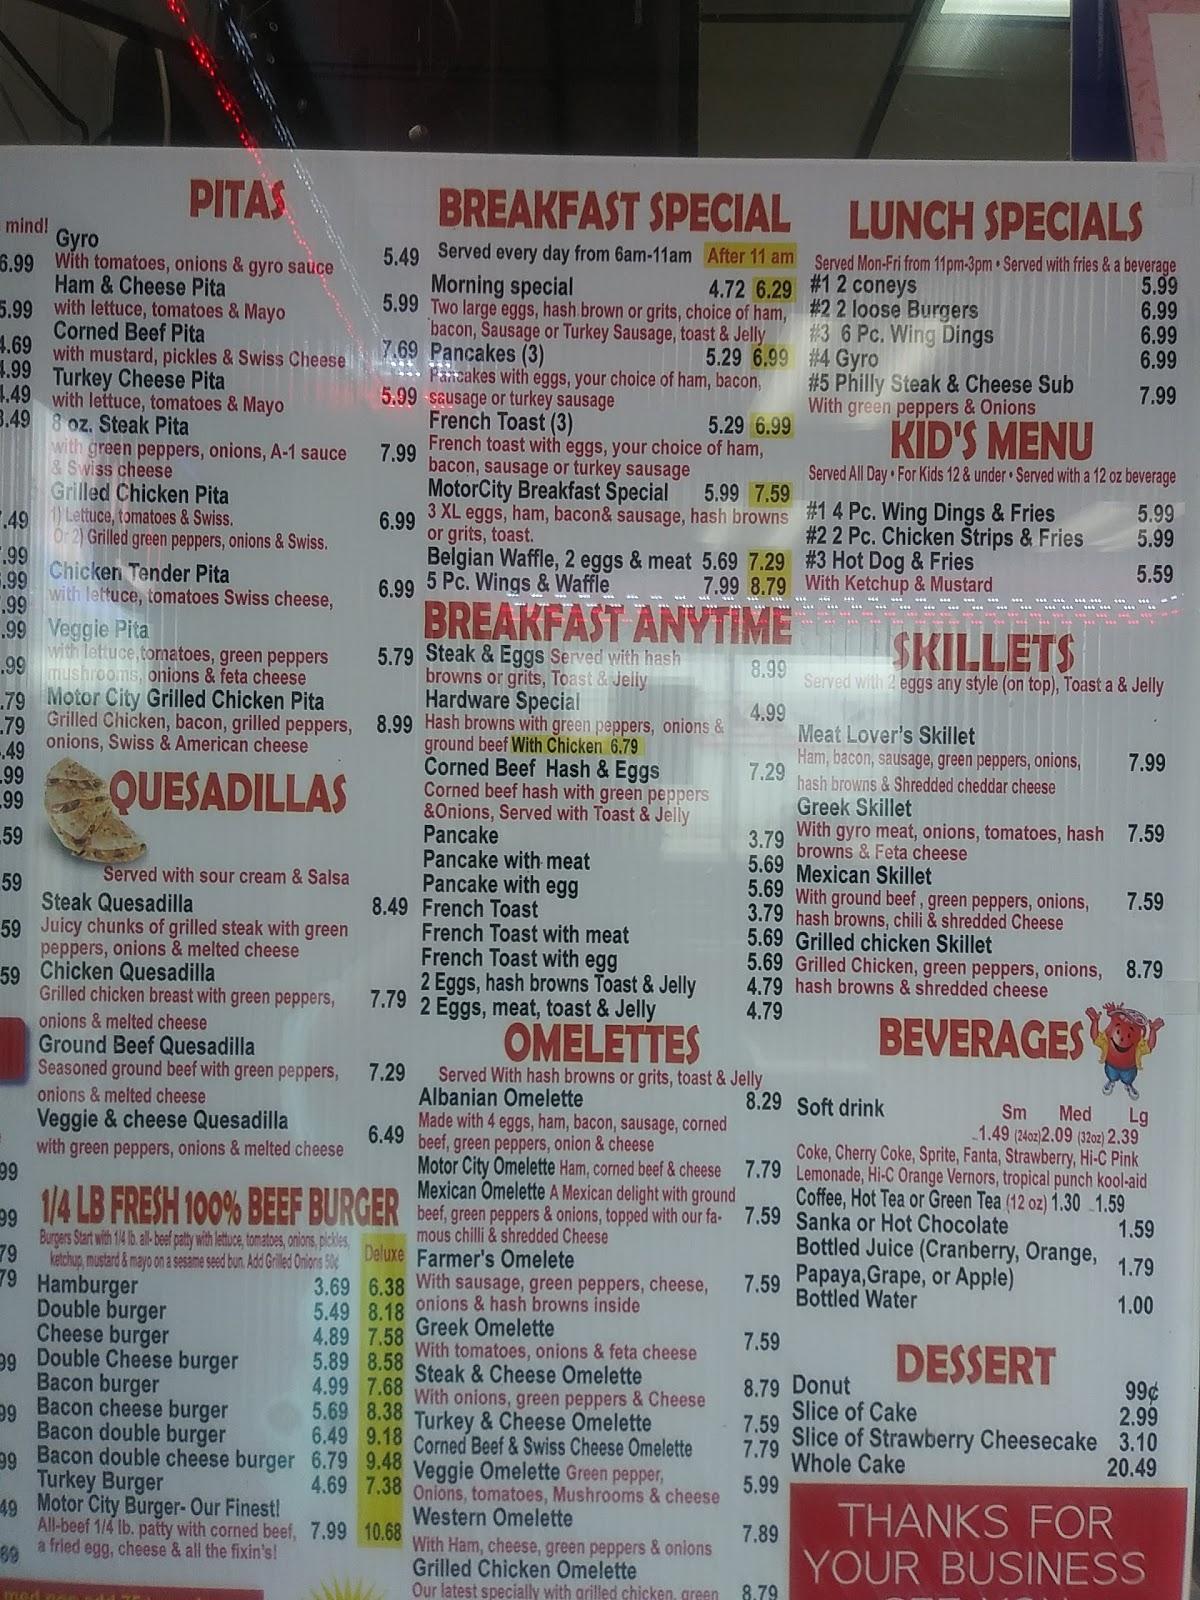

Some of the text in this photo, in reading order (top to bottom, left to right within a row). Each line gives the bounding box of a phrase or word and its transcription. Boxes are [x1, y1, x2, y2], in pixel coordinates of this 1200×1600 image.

[189, 178, 285, 221] PITAS
[439, 187, 791, 233] BREAKFAST SPECIAL
[5, 216, 48, 234] mind!
[849, 199, 1143, 242] LUNCH SPECIALS
[56, 227, 99, 251] Gyro
[383, 246, 419, 267] 5.49
[438, 241, 692, 266] Served every day from 6am-11am
[706, 246, 794, 264] After 11 am
[1003, 255, 1176, 274] Served with fries & a beverage
[55, 253, 334, 278] With tomatoes, onions & gyro sauce
[814, 254, 992, 276] Served Mon-Fri from 11pm-3pm
[55, 274, 225, 297] Ham & Cheese Pita
[431, 273, 573, 300] Morning special
[708, 279, 745, 299] 4.72
[756, 279, 792, 299] 6.29
[810, 273, 917, 299] #1 2 coneys
[1141, 275, 1178, 295] 5.99
[382, 293, 418, 313] 5.99
[808, 372, 1074, 397] #5 Philly Steak & Cheese Sub
[891, 419, 1093, 461] KID'S MENU
[428, 477, 668, 505] MotorCity Breakfast Special
[704, 483, 739, 502] 5.99
[754, 483, 790, 503] 7.59
[806, 500, 1055, 527] #1 4 Pc. Wing Dings & Fries
[1137, 503, 1174, 523] 5.99
[424, 600, 793, 645] BREAKFAST ANYTIME
[892, 631, 1075, 674] SKILLETS
[511, 736, 602, 754] With Chicken
[610, 737, 638, 755] 6.79
[109, 770, 347, 815] QUESADILLAS
[424, 824, 499, 844] Pancake
[748, 829, 784, 849] 3.79
[103, 863, 349, 885] Served with sour cream & Salsa
[796, 863, 932, 885] Mexican Skillet
[41, 891, 193, 913] Steak Quesadilla
[372, 896, 408, 916] 8.49
[1127, 891, 1164, 911] 7.59
[795, 931, 992, 954] Grilled chicken Skillet
[1126, 959, 1163, 979] 8.79
[504, 1022, 700, 1065] OMELETTES
[879, 1017, 1084, 1061] BEVERAGES
[418, 1086, 583, 1108] Albanian Omelette
[746, 1091, 782, 1110] 8.29
[797, 1096, 885, 1117] Soft drink
[1002, 1103, 1026, 1120] Sm
[1059, 1104, 1091, 1122] Med
[1129, 1106, 1148, 1127] Lg
[796, 1143, 1139, 1169] Coke, Cherry Coke, Sprite, Fanta, Strawberry, Hi-C Pink
[41, 1184, 399, 1227] 1/4 LB FRESH 100% BEEF BURGER
[796, 1211, 1008, 1235] Sanka or Hot Chocolate
[1119, 1218, 1154, 1239] 1.59
[364, 1243, 405, 1263] Deluxe
[38, 1273, 139, 1299] Hamburger
[314, 1276, 350, 1297] 3.69
[369, 1277, 404, 1297] 6.38
[415, 1316, 554, 1337] Greek Omelette
[744, 1331, 780, 1351] 7.59
[414, 1363, 642, 1385] Steak & Cheese Omelette
[896, 1343, 1056, 1385] DESSERT
[743, 1378, 779, 1398] 8.79
[793, 1374, 850, 1395] Donut
[1125, 1380, 1159, 1406] 99¢
[792, 1399, 917, 1422] Slice of Cake
[1119, 1406, 1158, 1427] 2.99
[792, 1426, 1097, 1454] Slice of Strawberry Cheesecake
[1119, 1431, 1157, 1452] 3.10
[791, 1452, 905, 1474] Whole Cake
[1107, 1457, 1157, 1478] 20.49
[36, 1468, 164, 1496] Turkey Burger
[311, 1474, 347, 1495] 4.69
[366, 1475, 402, 1495] 7.38
[838, 1502, 1113, 1540] THANKS FOR
[803, 1549, 1145, 1586] YOUR BUSINESS
